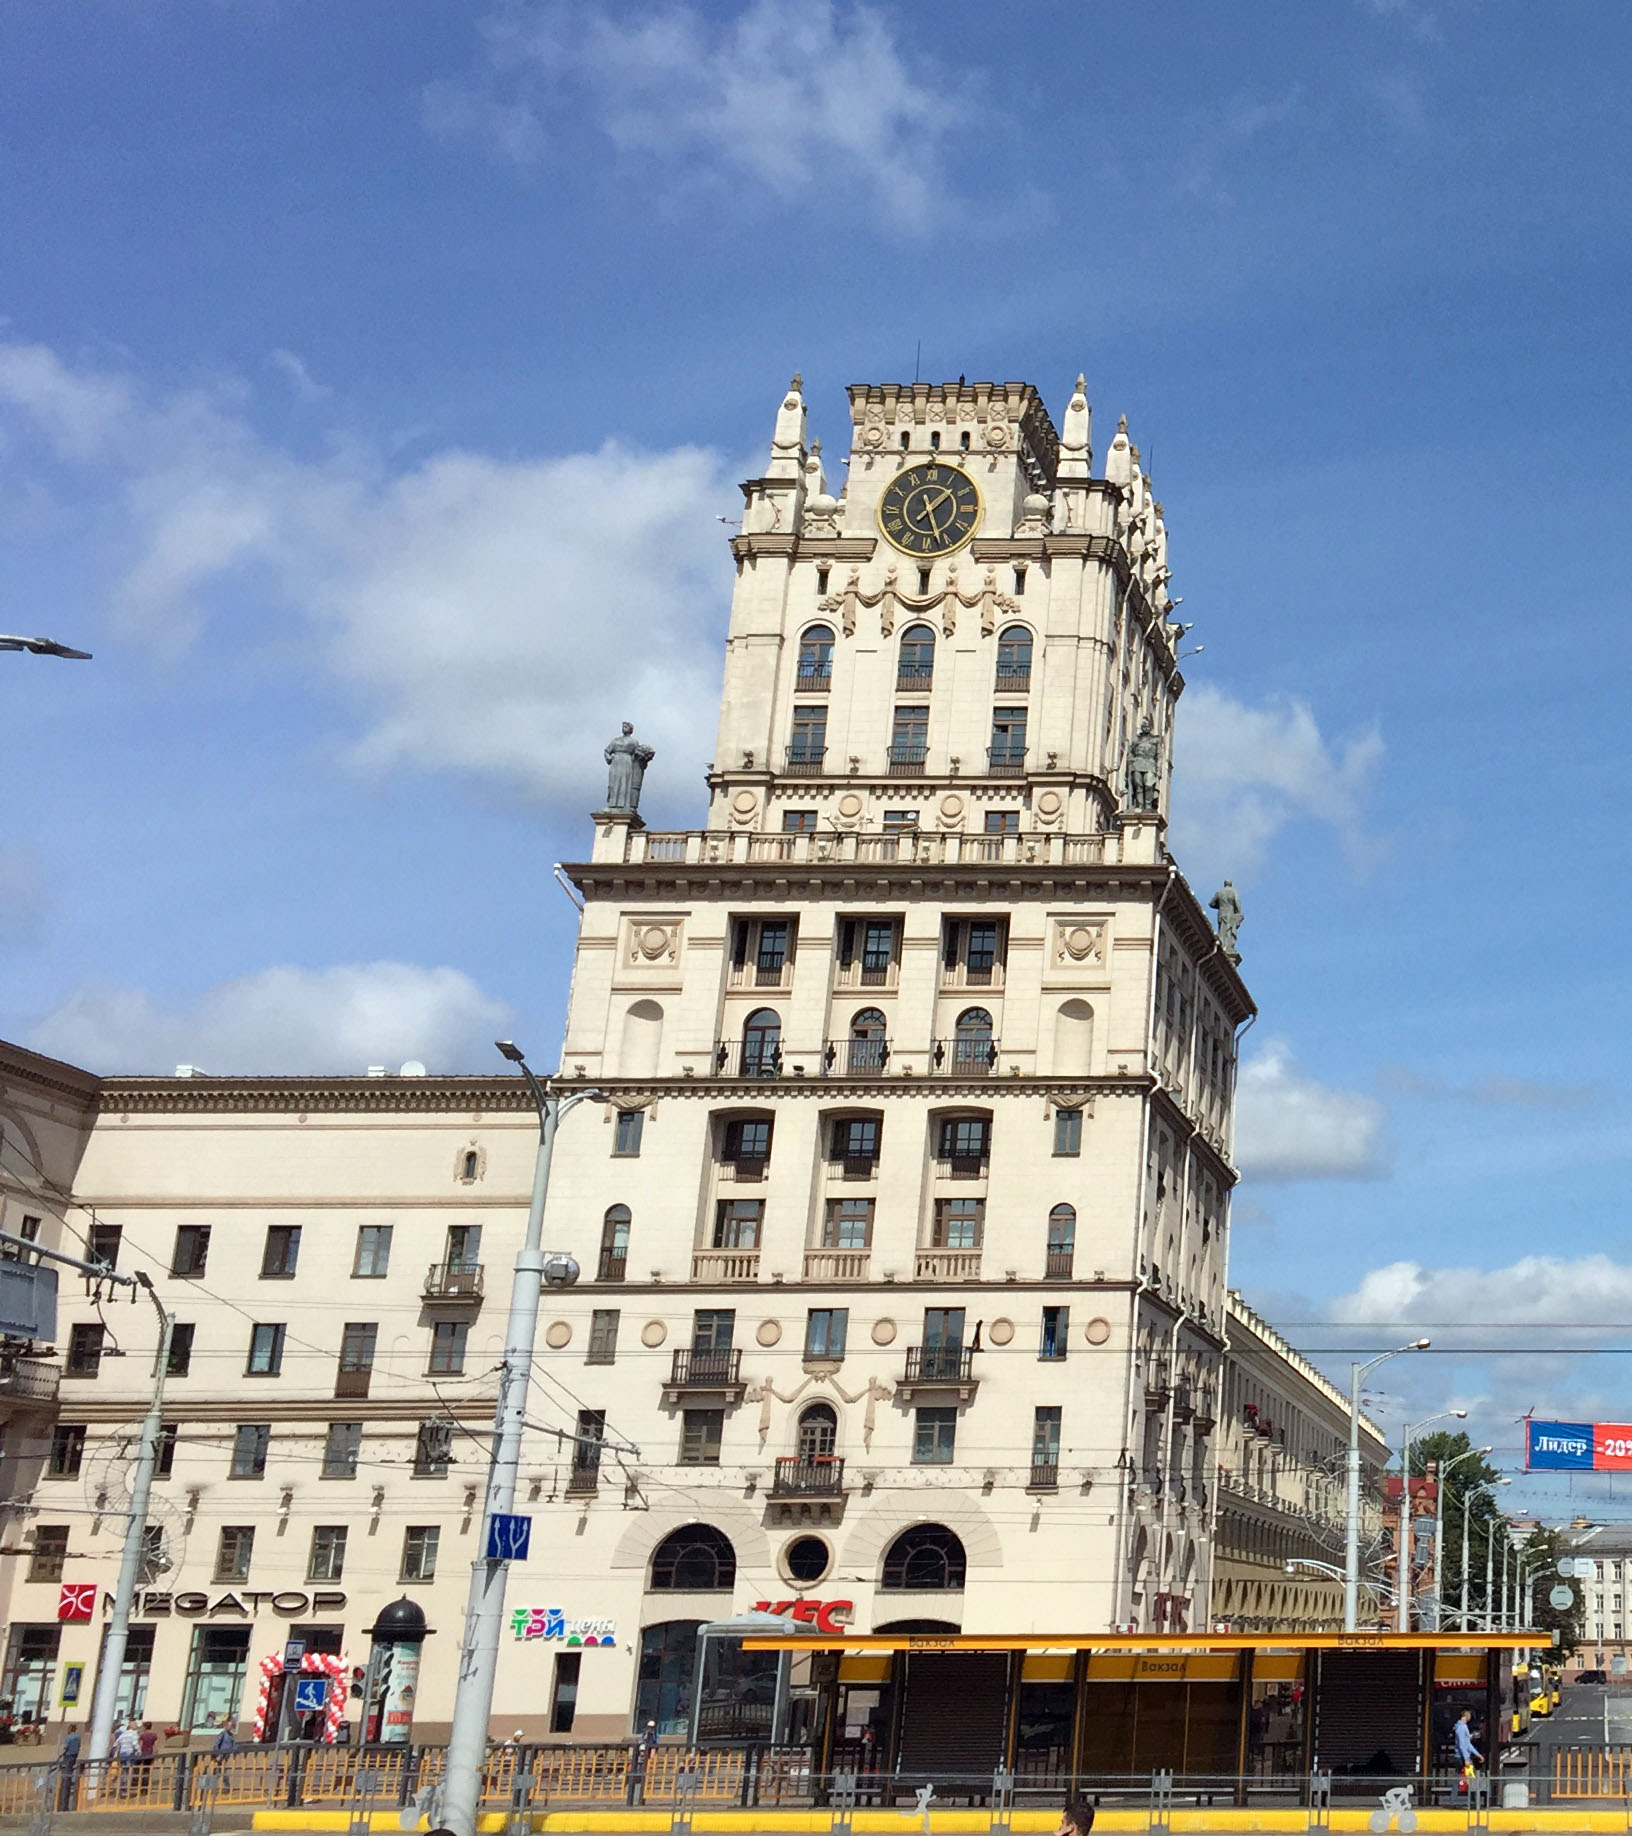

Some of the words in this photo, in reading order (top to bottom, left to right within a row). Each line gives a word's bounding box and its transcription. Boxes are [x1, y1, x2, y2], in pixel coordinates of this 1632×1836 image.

[1534, 1436, 1587, 1456] Лидер
[102, 1591, 347, 1613] MEGATOP
[511, 1617, 565, 1638] ТРИ
[909, 1636, 955, 1648] Вакзал
[1337, 1634, 1385, 1646] Вакзал
[1141, 1661, 1187, 1672] Вакзал
